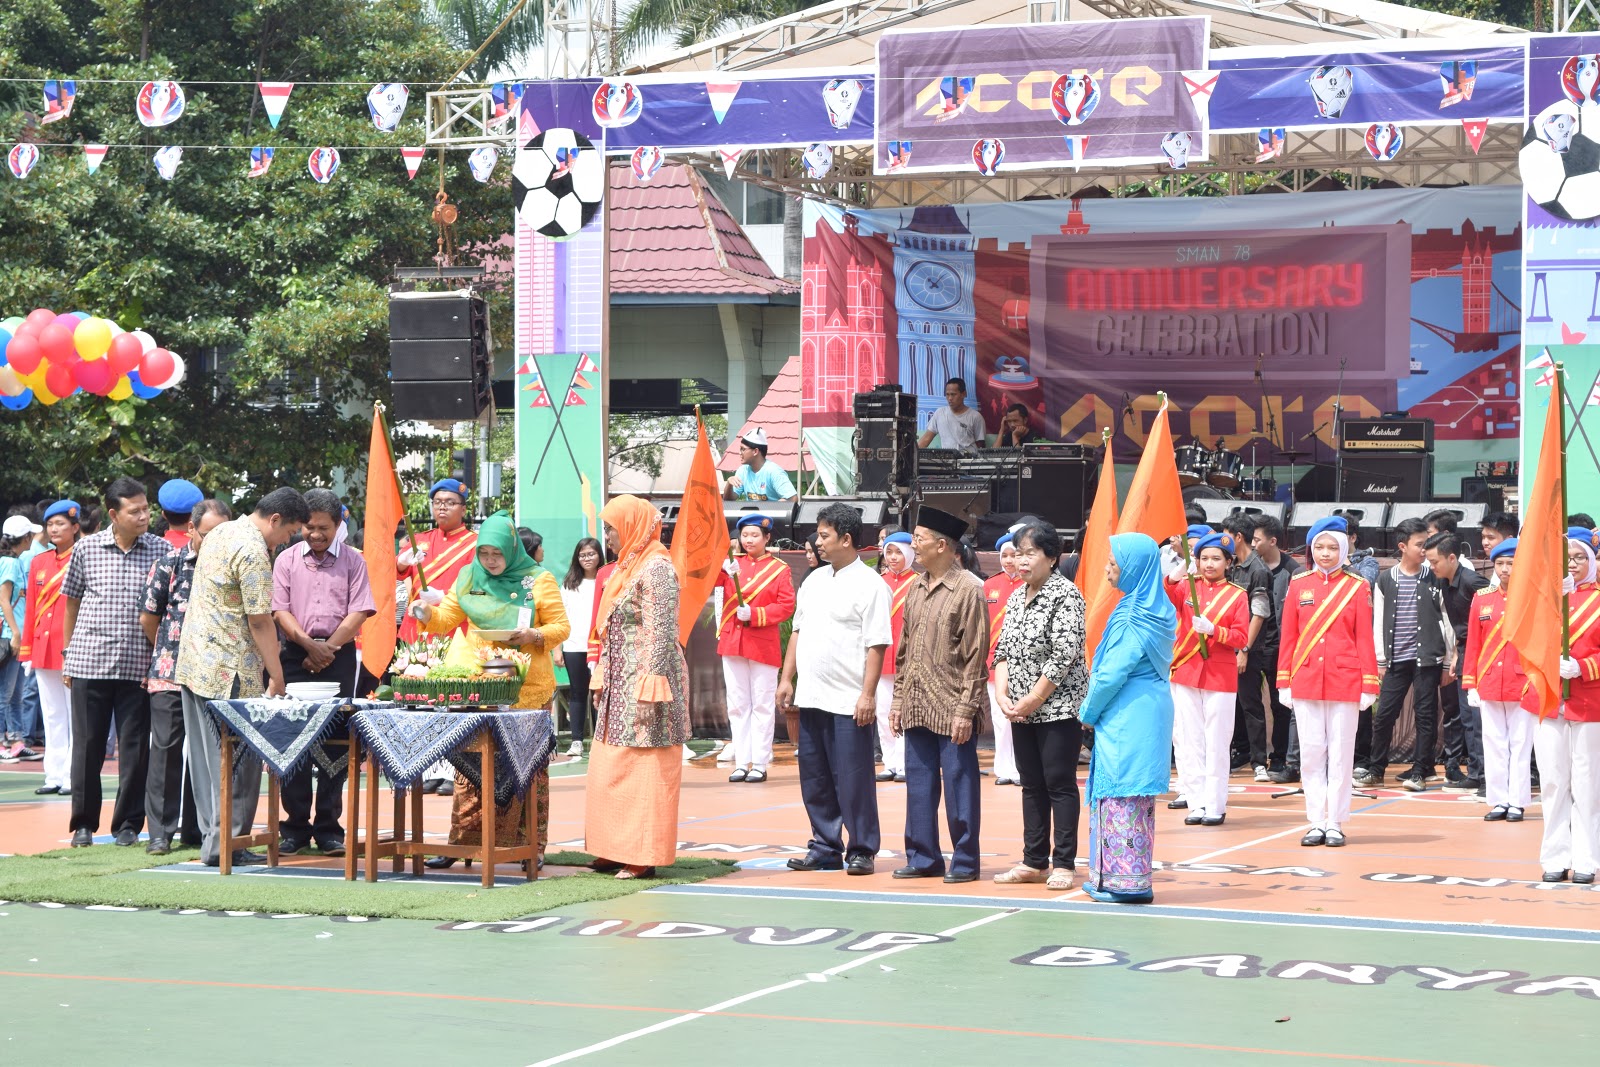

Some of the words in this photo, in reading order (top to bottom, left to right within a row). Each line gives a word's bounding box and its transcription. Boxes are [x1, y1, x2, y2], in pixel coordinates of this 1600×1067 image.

[1176, 246, 1220, 263] SMAN
[1234, 245, 1251, 261] 78
[1067, 263, 1364, 311] ANNIVERSARY
[1094, 312, 1329, 356] CELEBRATION
[1367, 426, 1402, 436] Marshall
[1363, 483, 1398, 493] Marshall
[436, 914, 953, 952] HIDUP
[1010, 944, 1600, 999] BANYA
